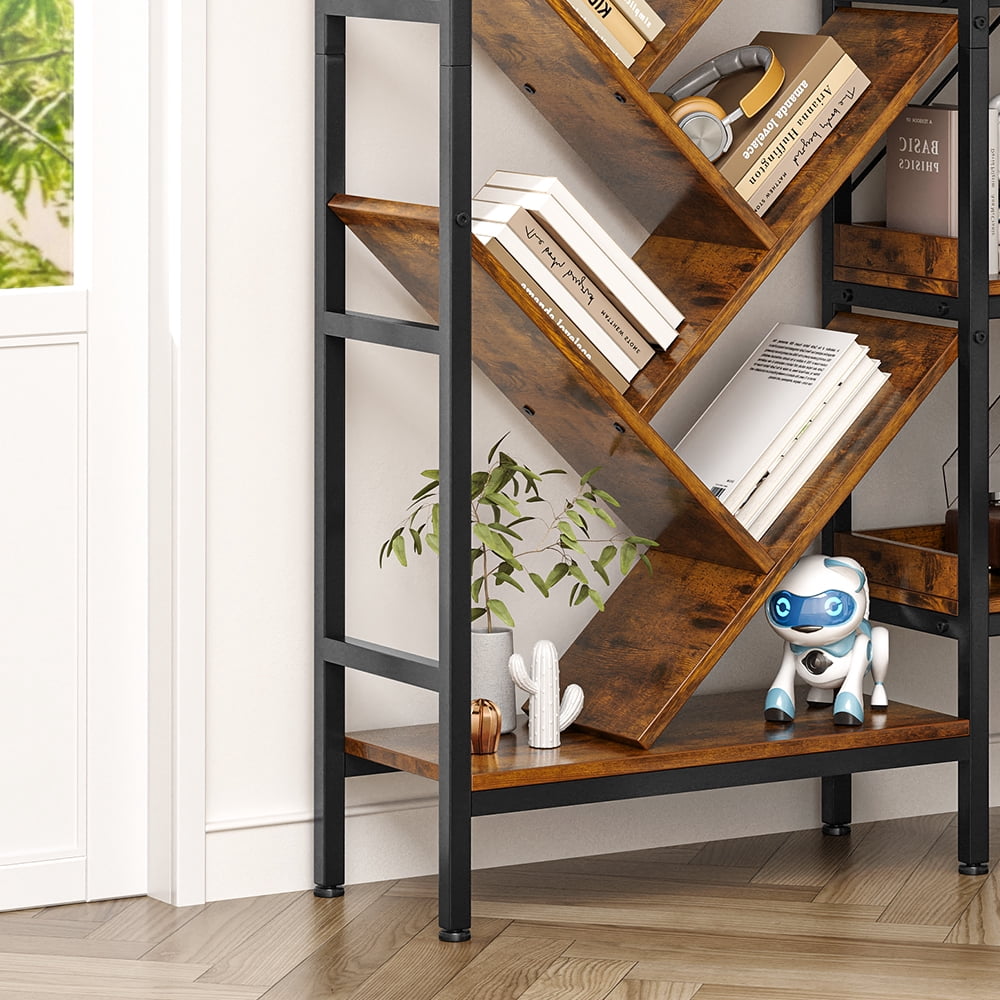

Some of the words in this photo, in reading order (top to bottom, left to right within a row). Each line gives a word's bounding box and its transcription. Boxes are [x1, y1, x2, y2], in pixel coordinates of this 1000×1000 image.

[774, 79, 809, 120] amanda
[797, 85, 832, 127] Arianna
[839, 86, 856, 106] The
[819, 108, 840, 129] body
[742, 120, 779, 160] lovelace
[749, 128, 799, 185] Huffington
[793, 131, 822, 166] beyond
[765, 172, 788, 198] MATTHEW
